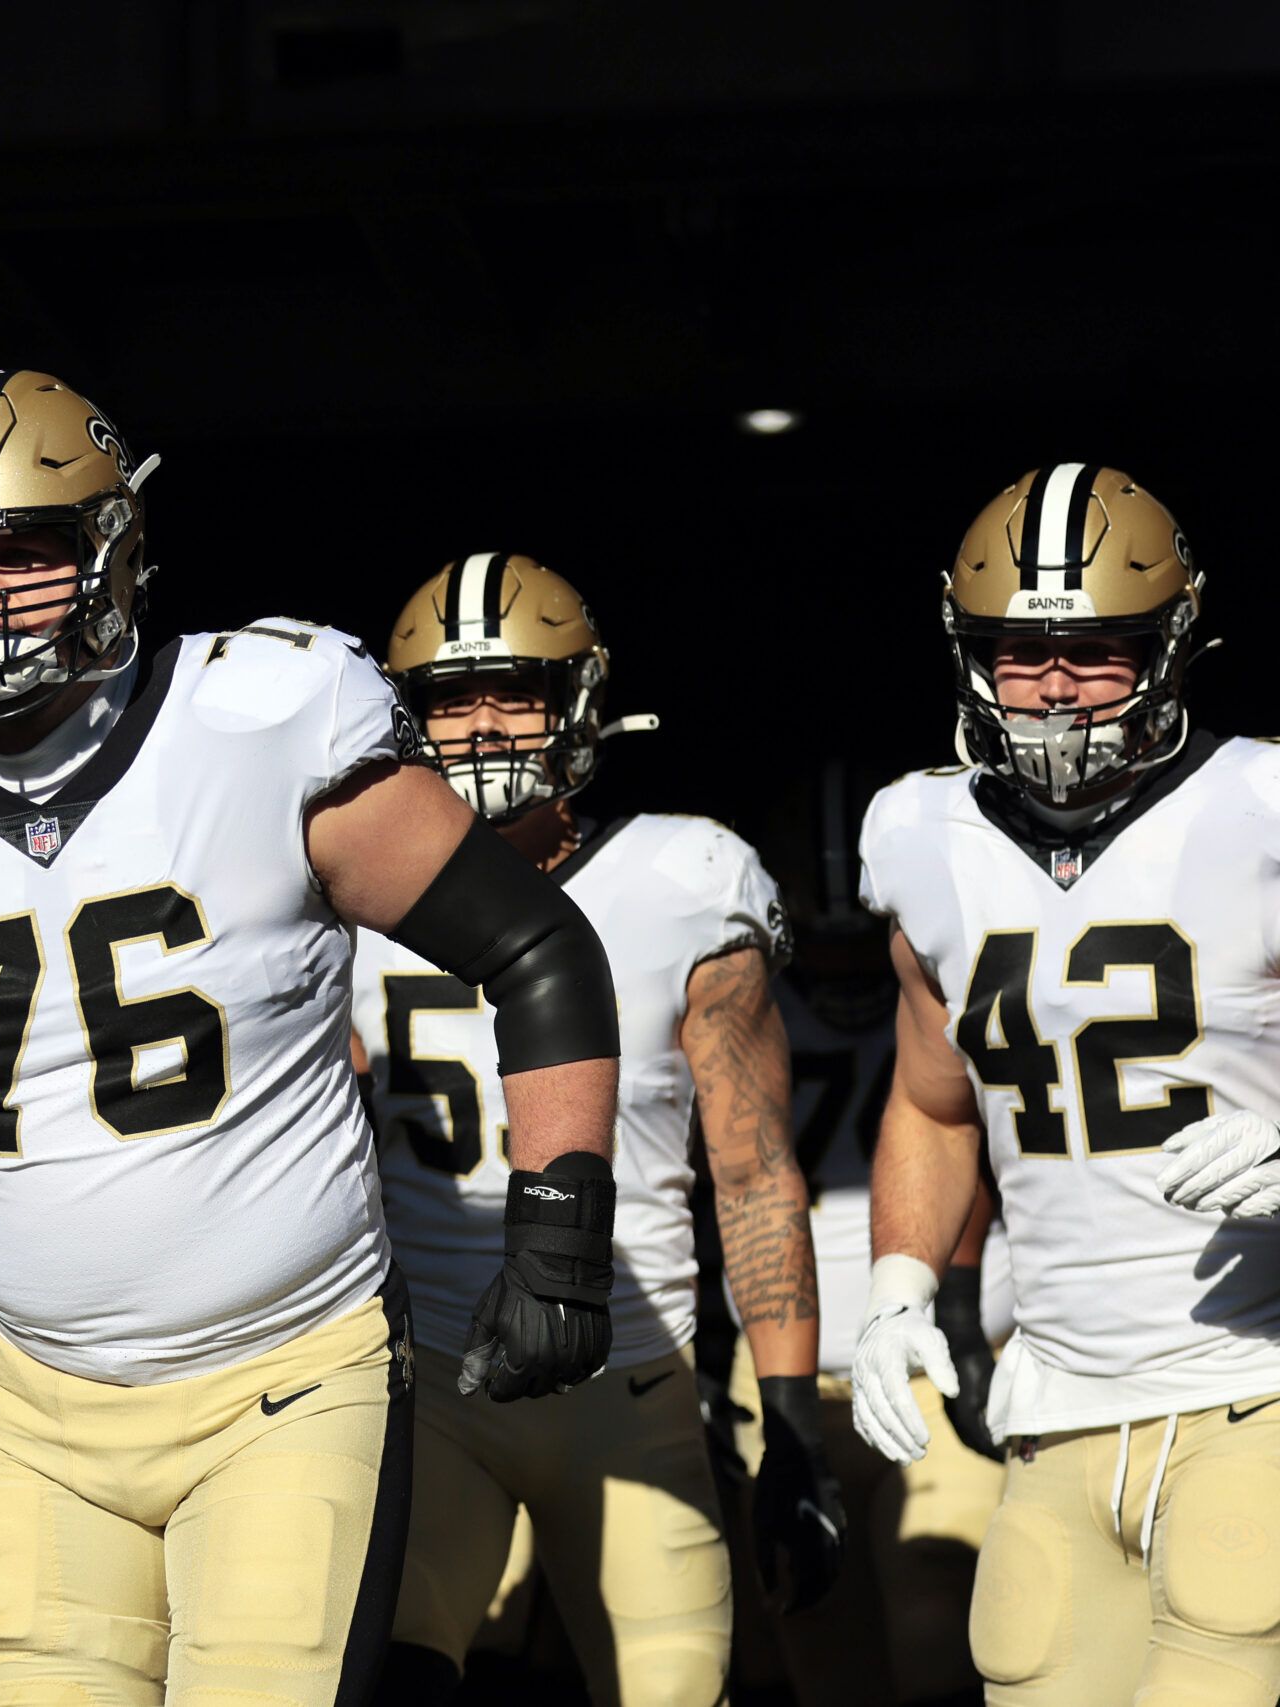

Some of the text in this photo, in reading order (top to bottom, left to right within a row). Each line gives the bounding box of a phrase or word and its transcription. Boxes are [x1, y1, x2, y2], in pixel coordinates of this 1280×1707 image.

[1028, 597, 1075, 611] SAINTS
[450, 640, 492, 655] SAINTS
[32, 832, 58, 852] NFL
[956, 919, 1215, 1160] 42
[380, 970, 513, 1182] 5
[523, 1186, 570, 1201] DONJOY
